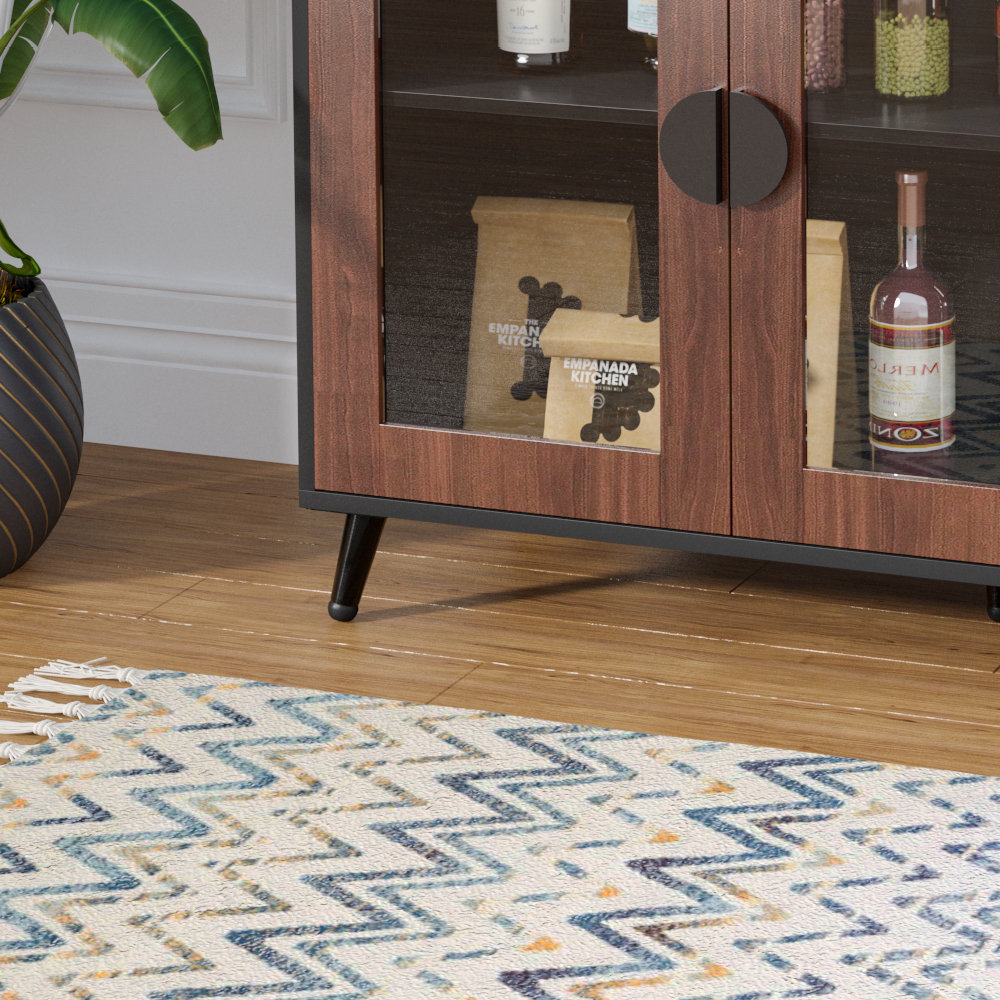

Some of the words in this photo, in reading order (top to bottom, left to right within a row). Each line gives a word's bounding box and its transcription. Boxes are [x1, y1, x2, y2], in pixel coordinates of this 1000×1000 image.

[488, 322, 540, 337] EMPAN
[497, 334, 542, 348] KITCH
[563, 356, 639, 375] EMPANADA
[570, 370, 629, 387] KITCHEN
